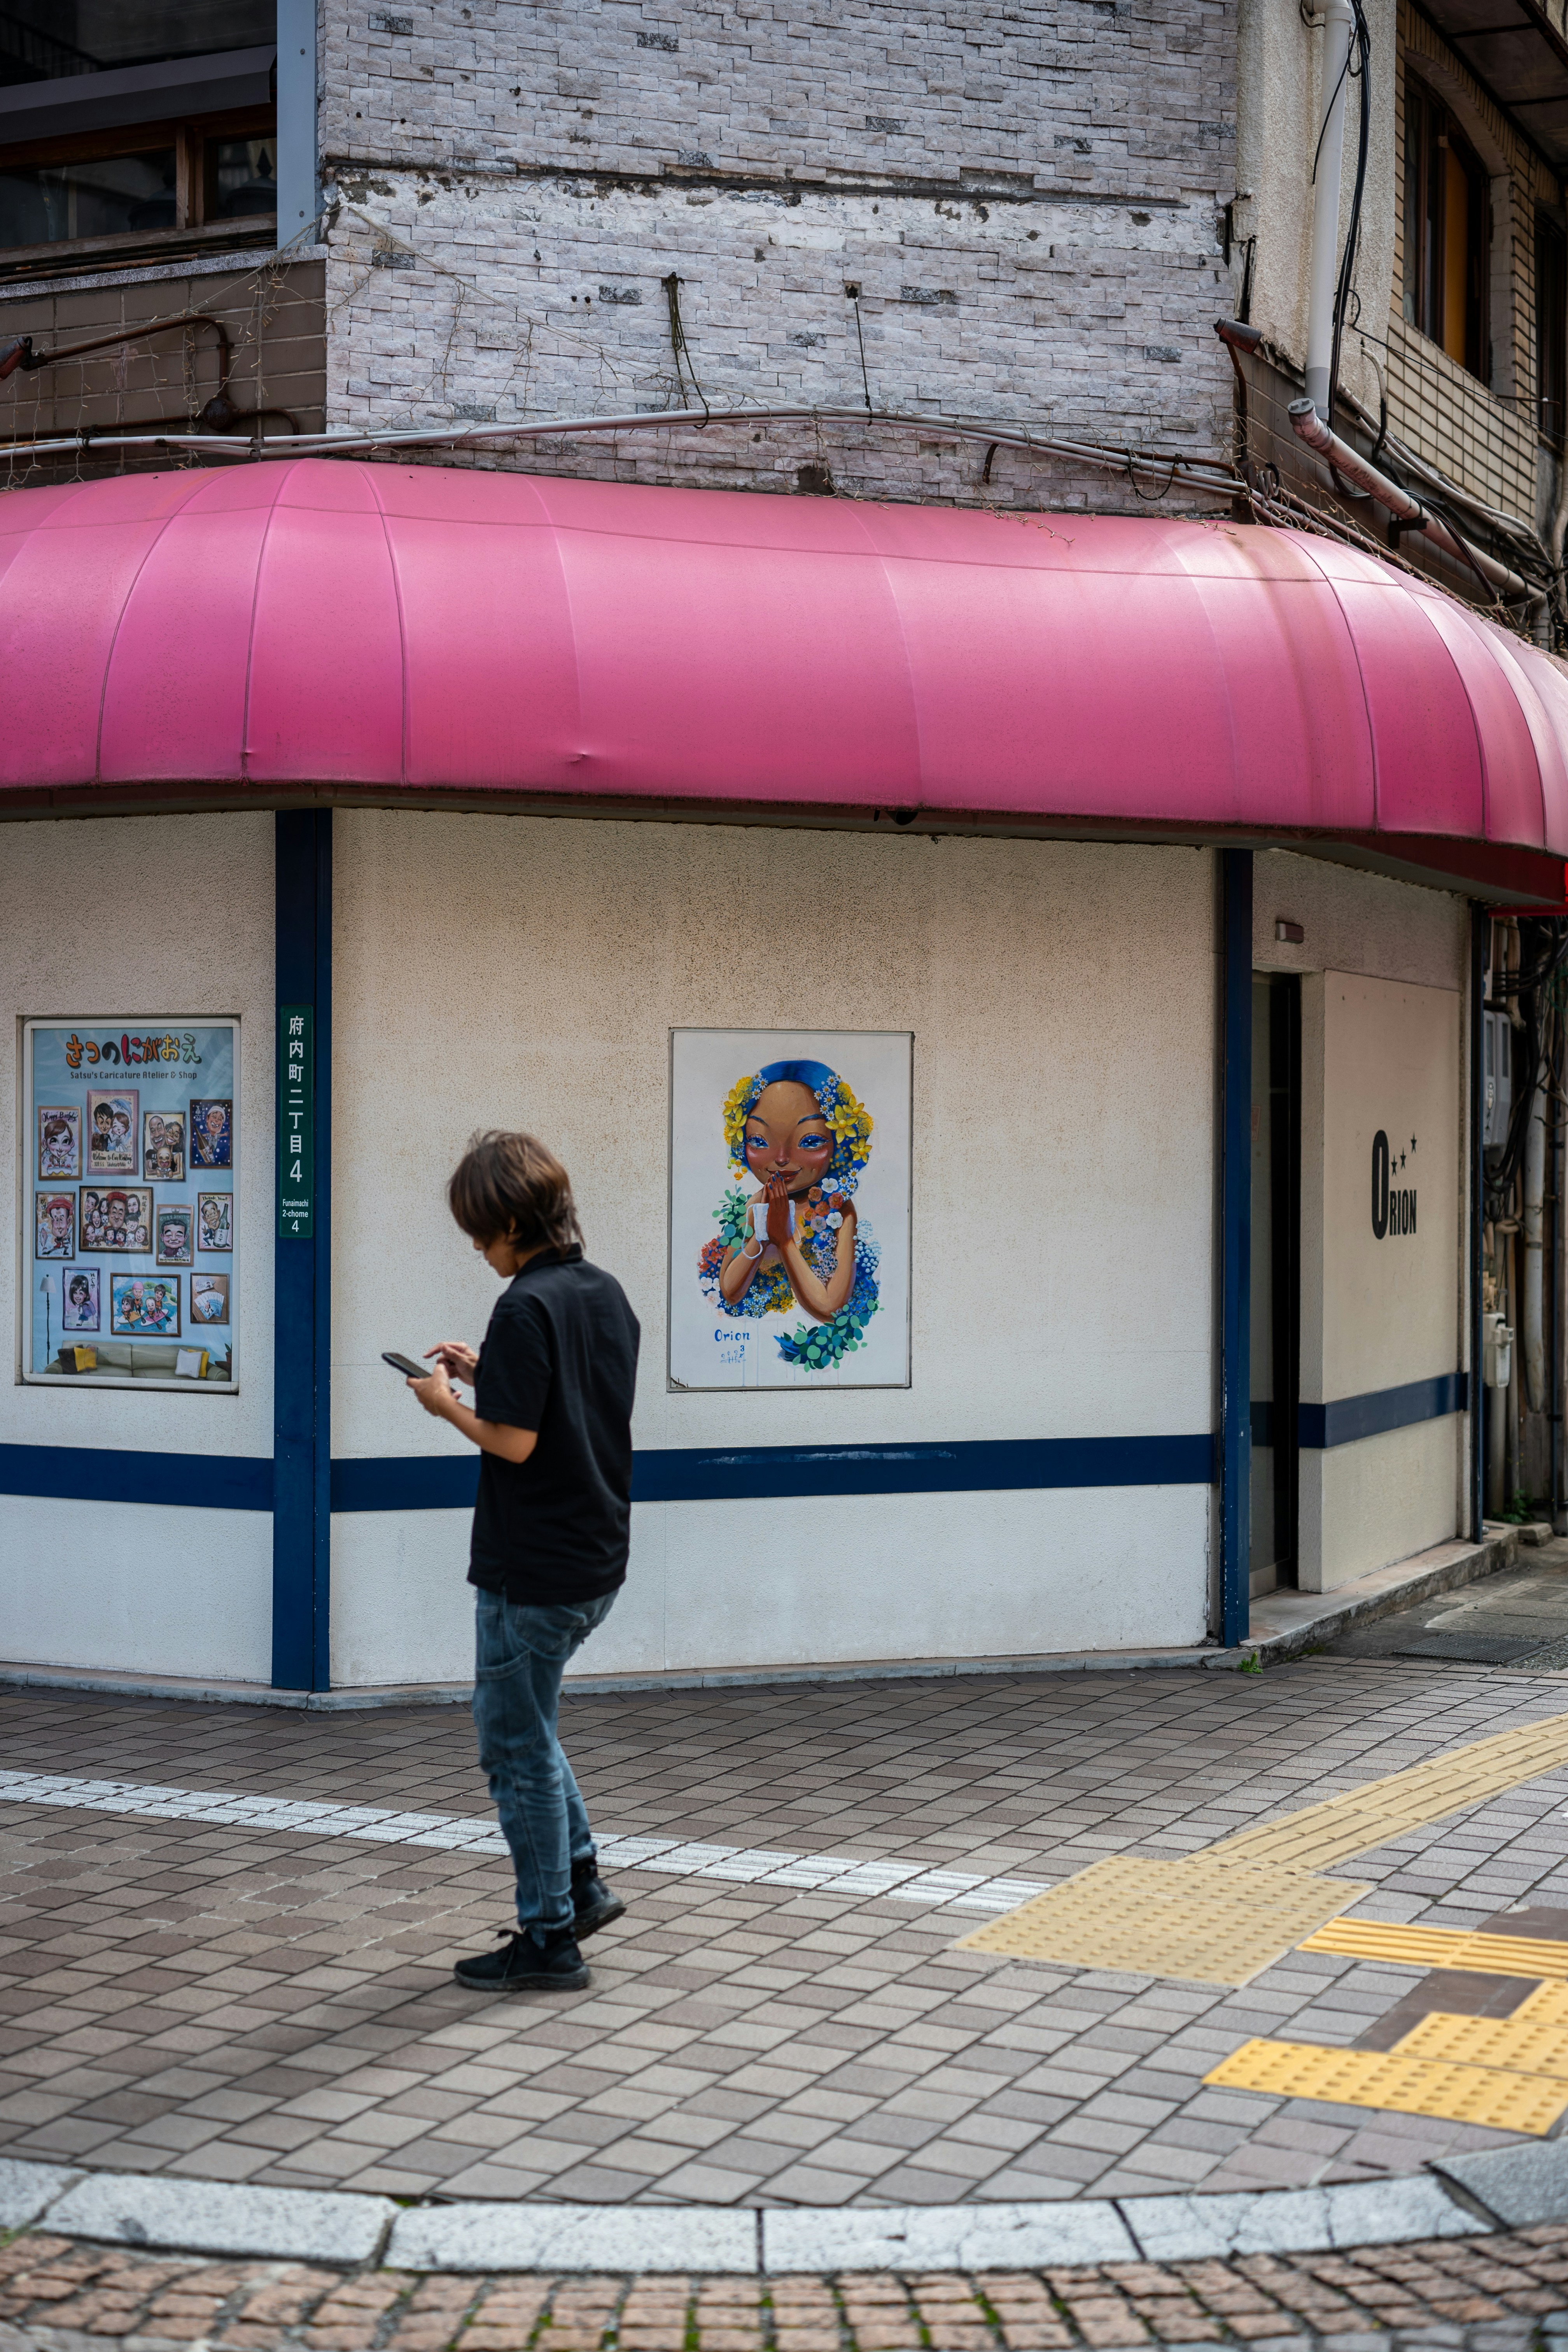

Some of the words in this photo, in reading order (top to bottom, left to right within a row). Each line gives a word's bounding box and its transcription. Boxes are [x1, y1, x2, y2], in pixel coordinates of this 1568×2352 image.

[66, 1034, 201, 1068] さつのにがおえ
[179, 1071, 197, 1080] Shop
[42, 1111, 57, 1122] Happy
[292, 1220, 299, 1232] 4
[715, 1329, 750, 1342] Orion
